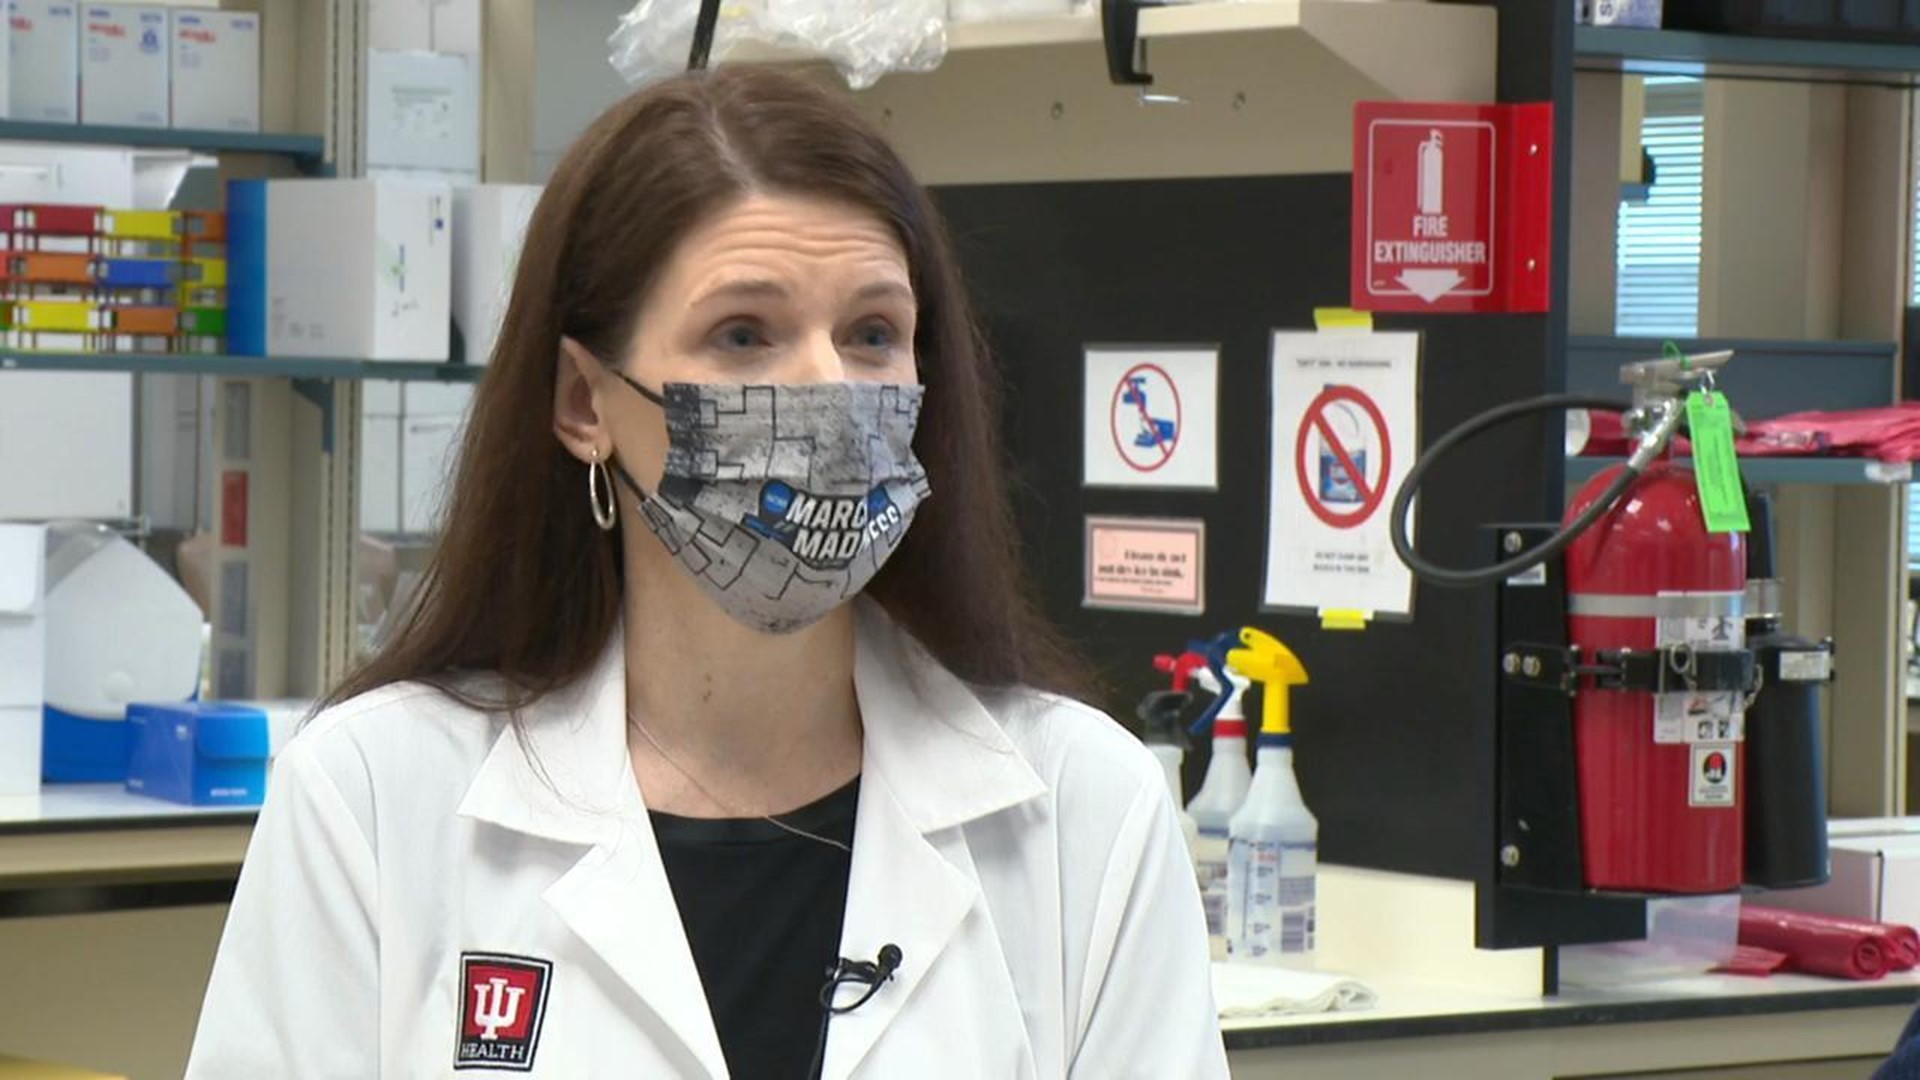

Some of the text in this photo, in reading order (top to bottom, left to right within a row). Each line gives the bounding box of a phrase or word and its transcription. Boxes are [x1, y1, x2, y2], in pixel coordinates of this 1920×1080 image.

[1413, 215, 1448, 237] FIRE
[1374, 241, 1486, 264] EXTINGUISHER
[785, 492, 869, 529] MARC
[461, 1042, 525, 1060] HEALTH
